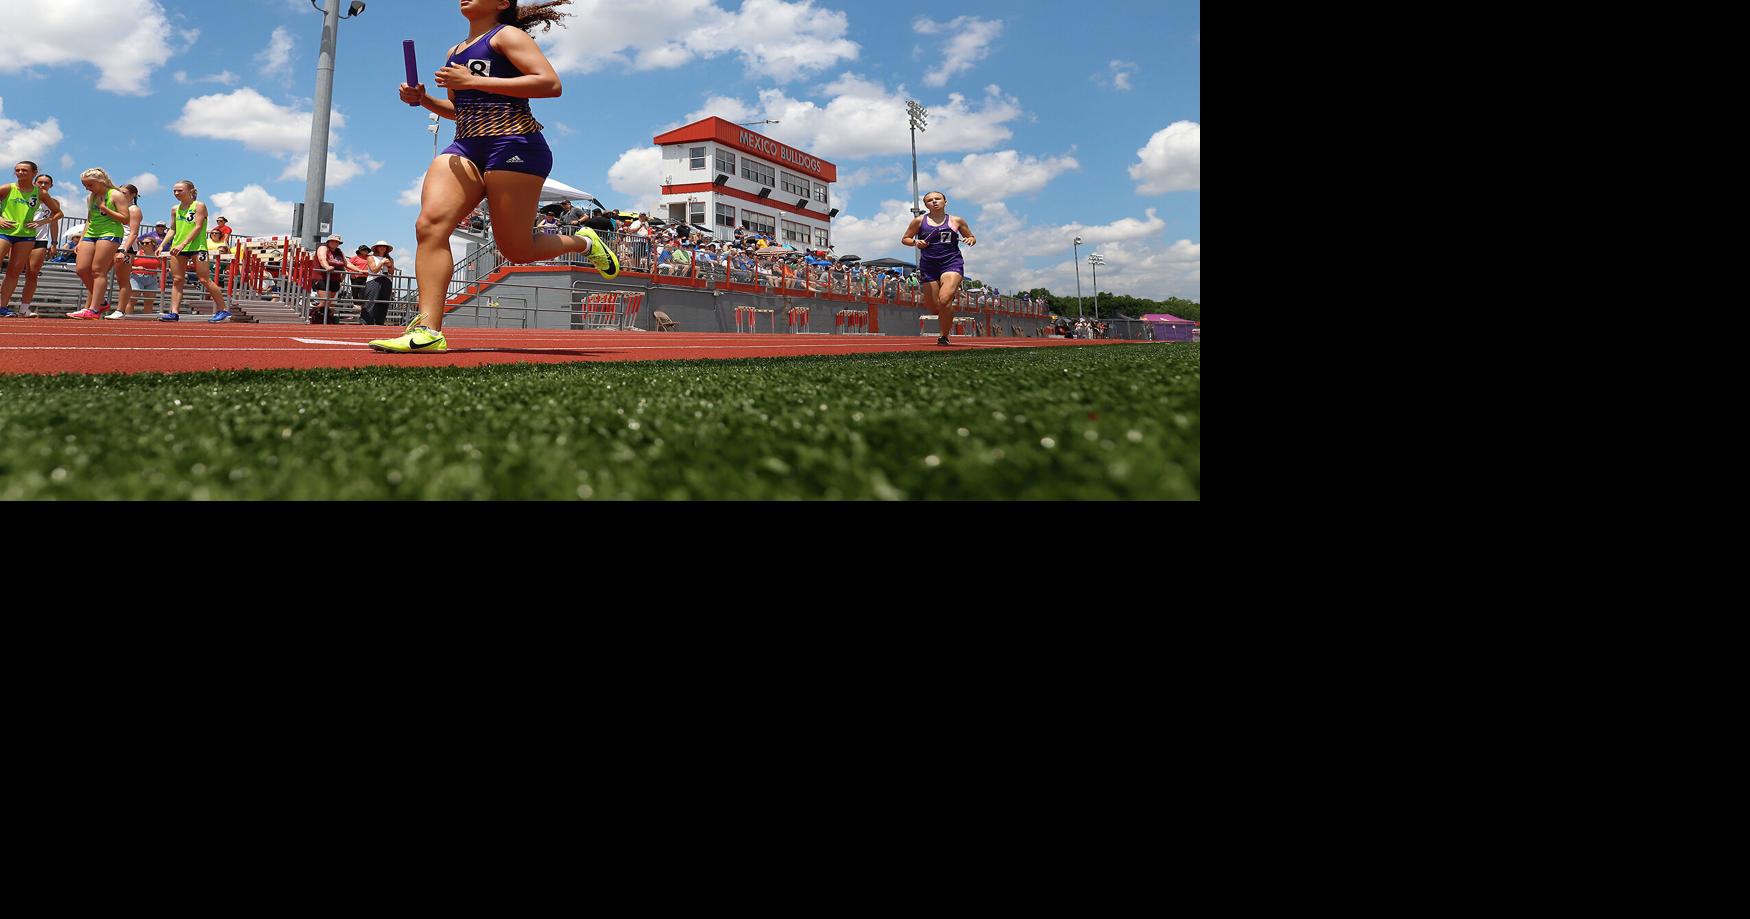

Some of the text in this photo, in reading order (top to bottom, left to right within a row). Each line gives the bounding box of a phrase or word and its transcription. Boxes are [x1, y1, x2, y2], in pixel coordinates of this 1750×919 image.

[739, 130, 821, 173] MEXICO BULLDOGS
[30, 197, 37, 207] 3
[186, 212, 195, 222] 3
[941, 232, 951, 243] 7
[199, 252, 207, 261] 3
